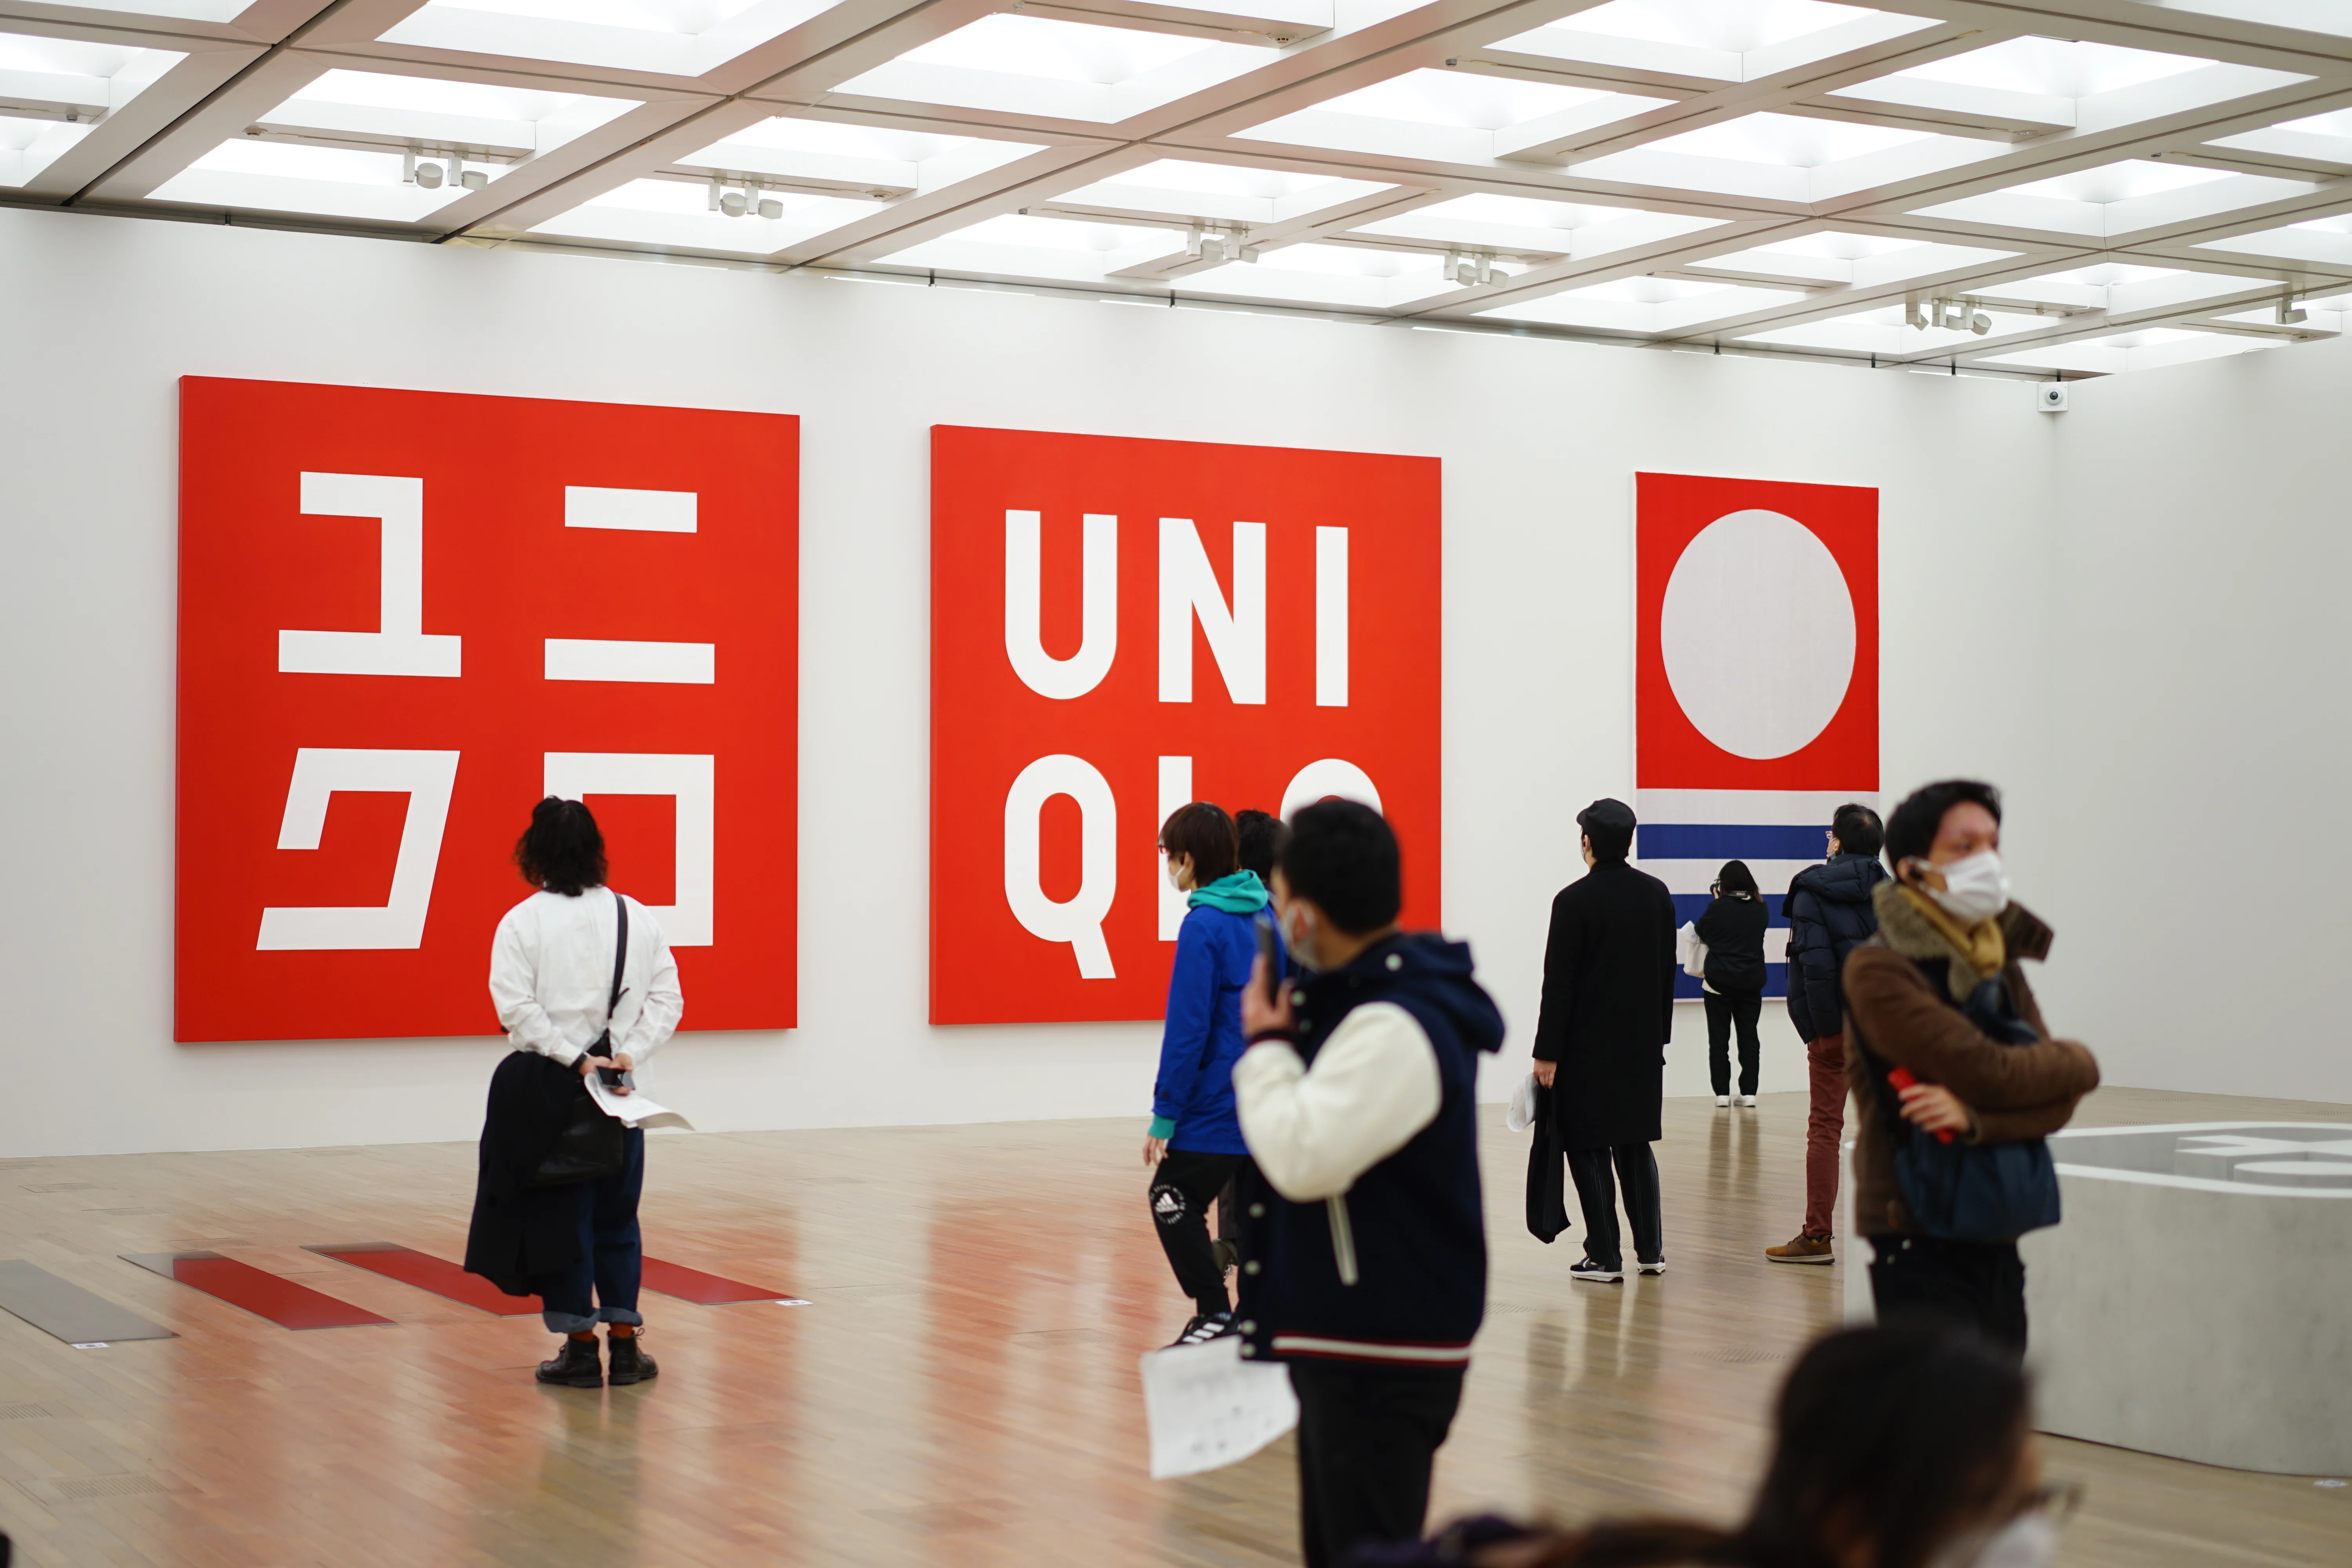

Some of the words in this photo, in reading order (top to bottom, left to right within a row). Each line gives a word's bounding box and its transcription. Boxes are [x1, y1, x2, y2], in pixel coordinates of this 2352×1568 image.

[279, 472, 715, 684] ユニ
[1005, 510, 1348, 707] UNI
[256, 748, 715, 950] クロ
